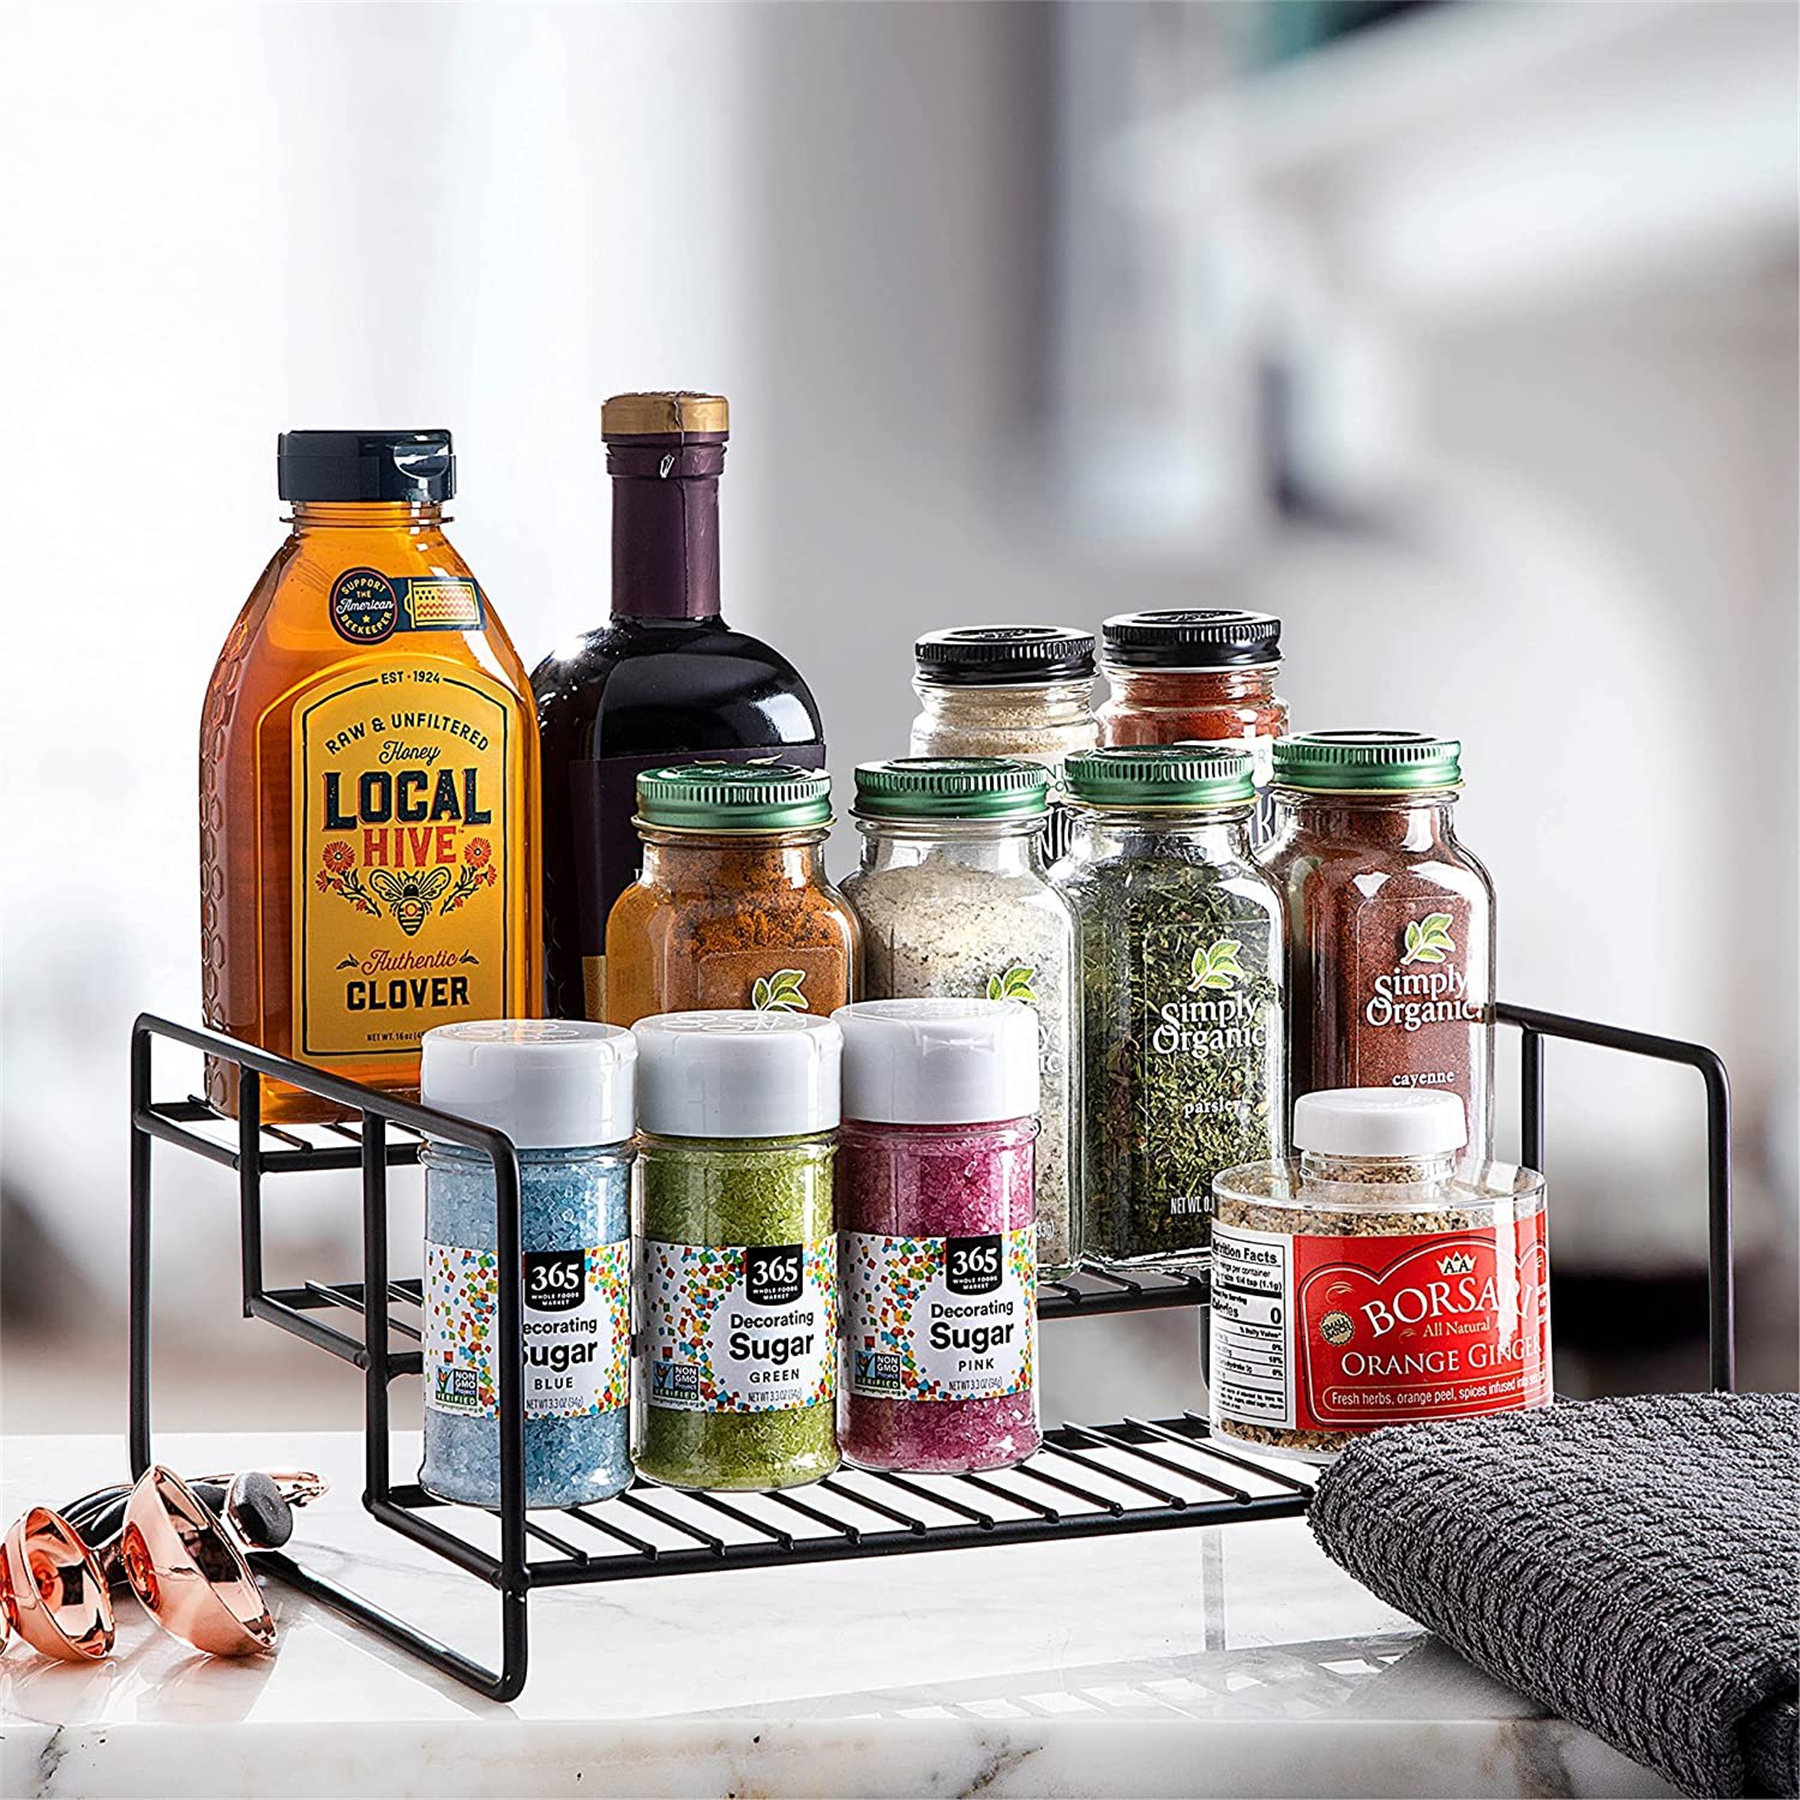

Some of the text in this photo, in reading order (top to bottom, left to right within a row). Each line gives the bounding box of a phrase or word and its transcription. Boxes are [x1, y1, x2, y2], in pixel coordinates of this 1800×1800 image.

[341, 578, 387, 596] SUPPORT
[356, 590, 371, 598] THE
[336, 598, 394, 614] American
[340, 611, 393, 635] BEEKEEPER
[381, 671, 440, 685] EST 1924
[325, 712, 489, 755] RAW & UNFILTERED
[379, 741, 441, 766] Honey
[322, 768, 491, 831] LOCAL
[363, 826, 456, 868] HIVE
[361, 949, 458, 975] Authentic
[1374, 964, 1469, 1000] Simply
[346, 976, 470, 1011] CLOVER
[1161, 991, 1260, 1028] Simply
[1153, 1023, 1266, 1060] Organic
[1392, 1071, 1455, 1088] cayenne
[1184, 1097, 1241, 1118] parsley
[1170, 1197, 1186, 1214] NET
[952, 1246, 998, 1276] 365
[1244, 1248, 1277, 1264] Facts
[531, 1262, 580, 1291] 365
[752, 1256, 798, 1285] 365
[952, 1277, 976, 1285] WHOLE
[931, 1301, 1014, 1319] Decorating
[1270, 1307, 1282, 1324] 0
[523, 1317, 597, 1334] ecorating
[730, 1311, 814, 1329] Decorating
[1423, 1317, 1491, 1338] All Natural
[929, 1322, 1014, 1354] Sugar
[729, 1332, 814, 1366] Sugar
[877, 1355, 898, 1364] NON
[877, 1363, 899, 1373] GMO
[958, 1358, 995, 1372] PINK
[1341, 1350, 1460, 1376] ORANGE
[455, 1371, 476, 1381] NON
[675, 1366, 697, 1375] NON
[675, 1374, 698, 1384] GMO
[750, 1369, 800, 1383] GREEN
[455, 1379, 476, 1389] GMO
[534, 1377, 574, 1390] BLUE
[1332, 1392, 1360, 1405] Fresh
[1397, 1391, 1432, 1405] orange
[1459, 1381, 1487, 1400] spices
[1488, 1376, 1516, 1395] infused
